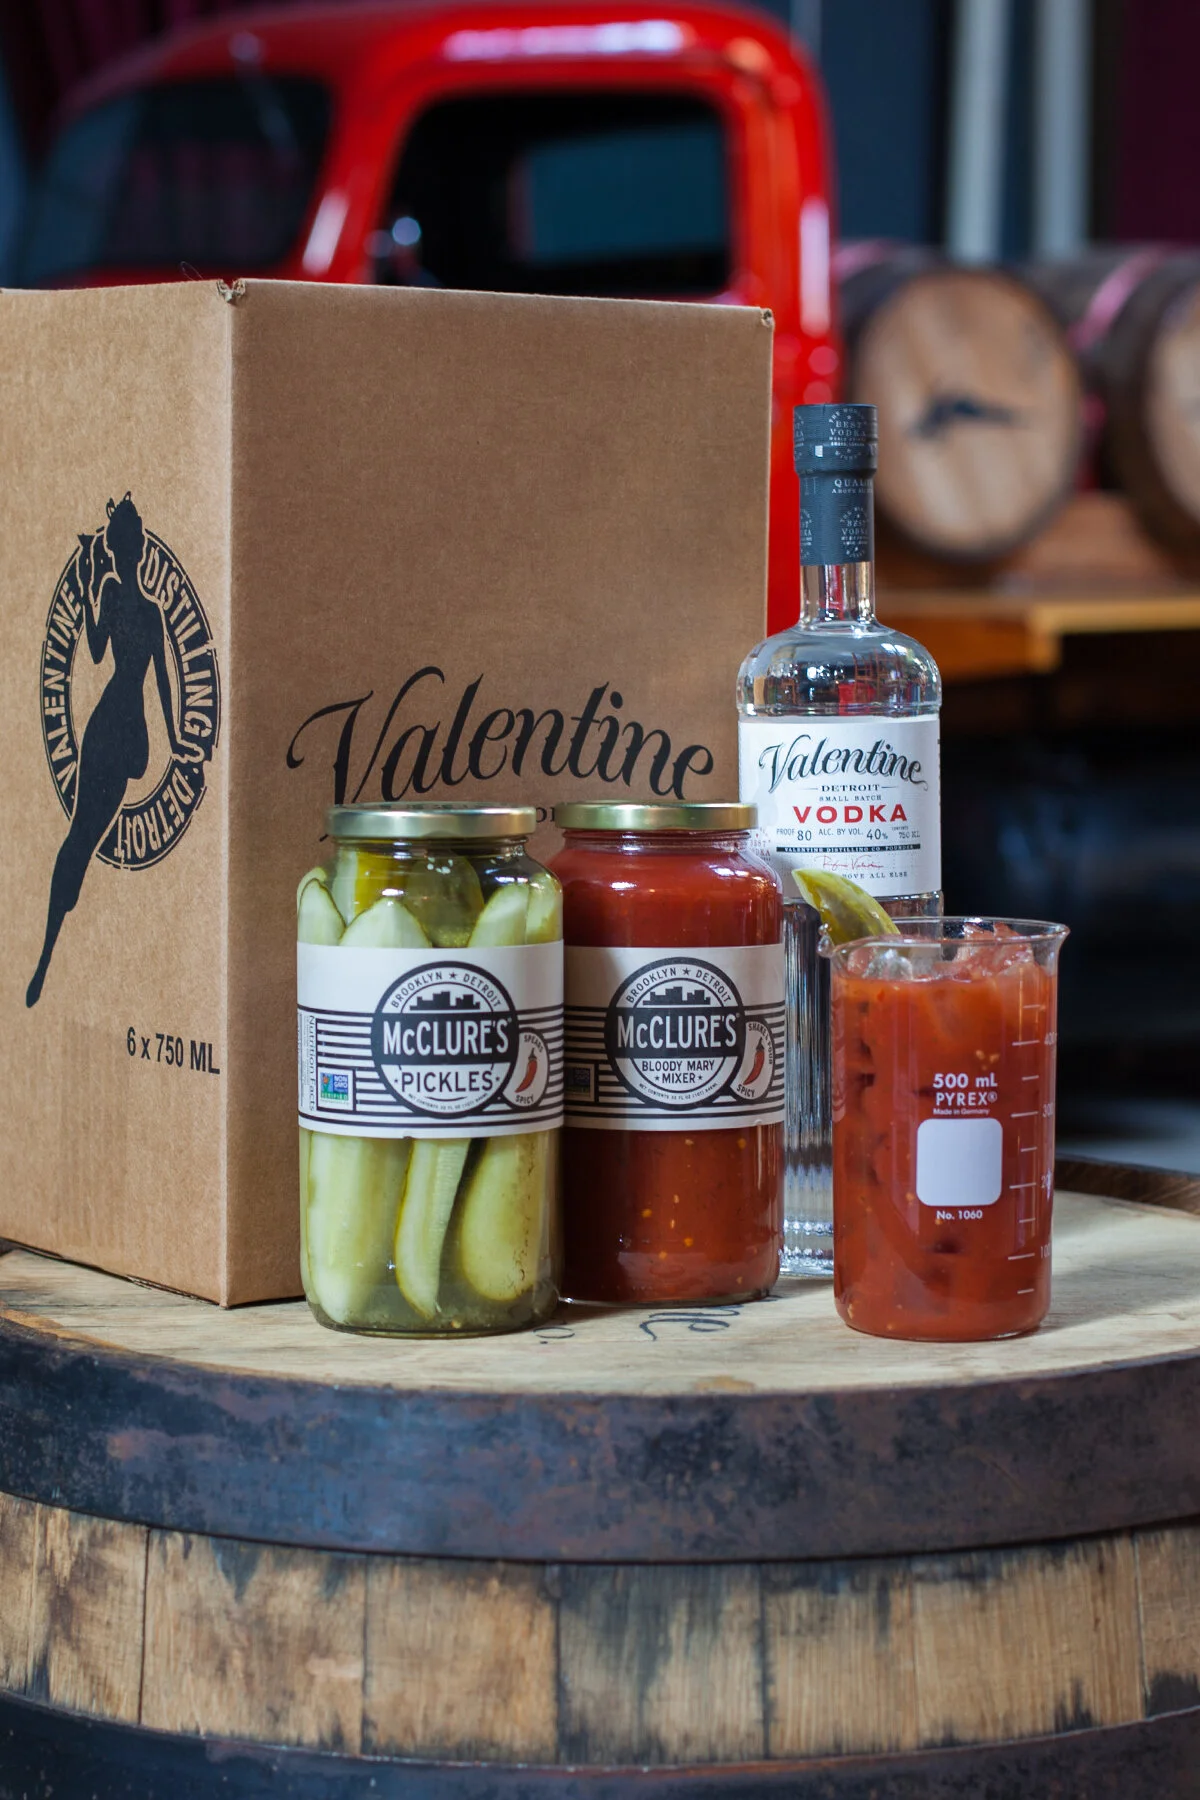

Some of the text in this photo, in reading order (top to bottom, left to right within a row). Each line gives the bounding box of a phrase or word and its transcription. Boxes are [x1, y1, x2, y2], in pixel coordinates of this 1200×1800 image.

[44, 546, 214, 860] VALENTINE DISTILLING DETROIT
[286, 666, 715, 803] Valentine
[759, 734, 928, 793] Valentine
[821, 784, 880, 793] DETROIT
[792, 803, 908, 824] VODKA
[776, 828, 796, 837] PROOF
[797, 830, 812, 841] 80
[837, 828, 847, 836] BY
[390, 971, 502, 1009] BROOKLYN DETROIT
[626, 967, 732, 1004] BROOKLYN DETROIT
[127, 1026, 220, 1075] 6 x 750 ML
[641, 1059, 715, 1072] BLOODY MARY
[401, 1070, 493, 1093] PICKLES
[661, 1072, 696, 1084] MIXER
[932, 1071, 998, 1089] 500 mL
[515, 1093, 534, 1104] SPICY
[736, 1083, 756, 1098] SPICY
[932, 1107, 953, 1115] Made
[961, 1107, 990, 1116] Germany
[936, 1209, 983, 1220] No. 1060
